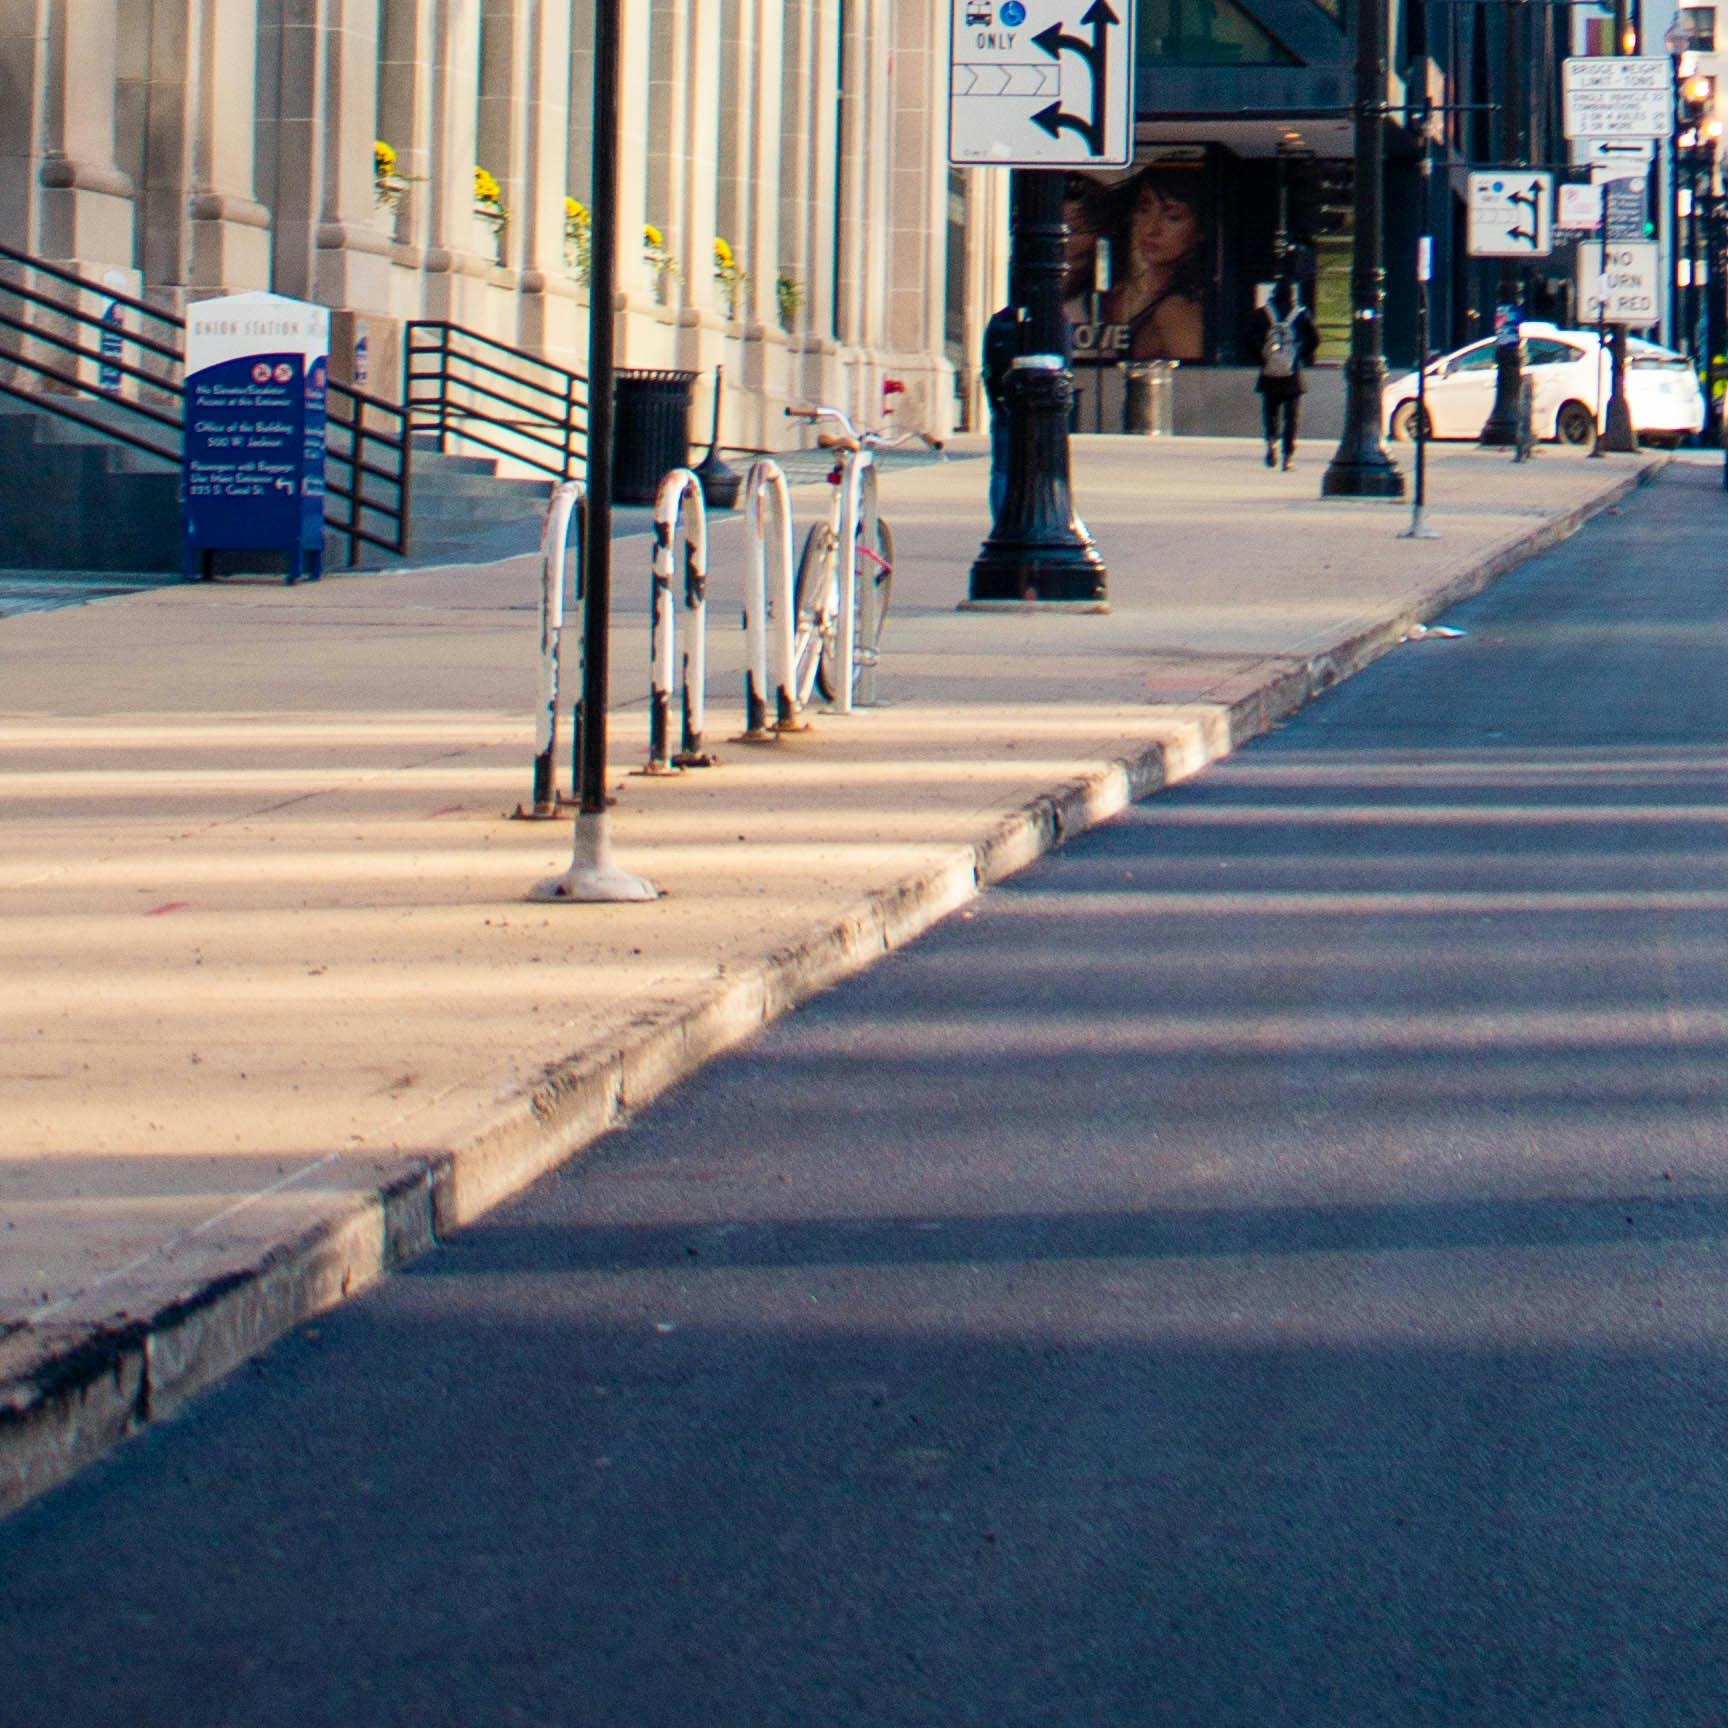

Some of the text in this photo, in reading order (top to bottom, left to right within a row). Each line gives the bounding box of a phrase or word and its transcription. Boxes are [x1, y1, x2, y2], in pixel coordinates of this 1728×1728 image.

[976, 32, 1017, 49] ONLY
[1607, 273, 1642, 289] URN
[1616, 295, 1651, 312] RED
[194, 319, 301, 336] UNION STATION
